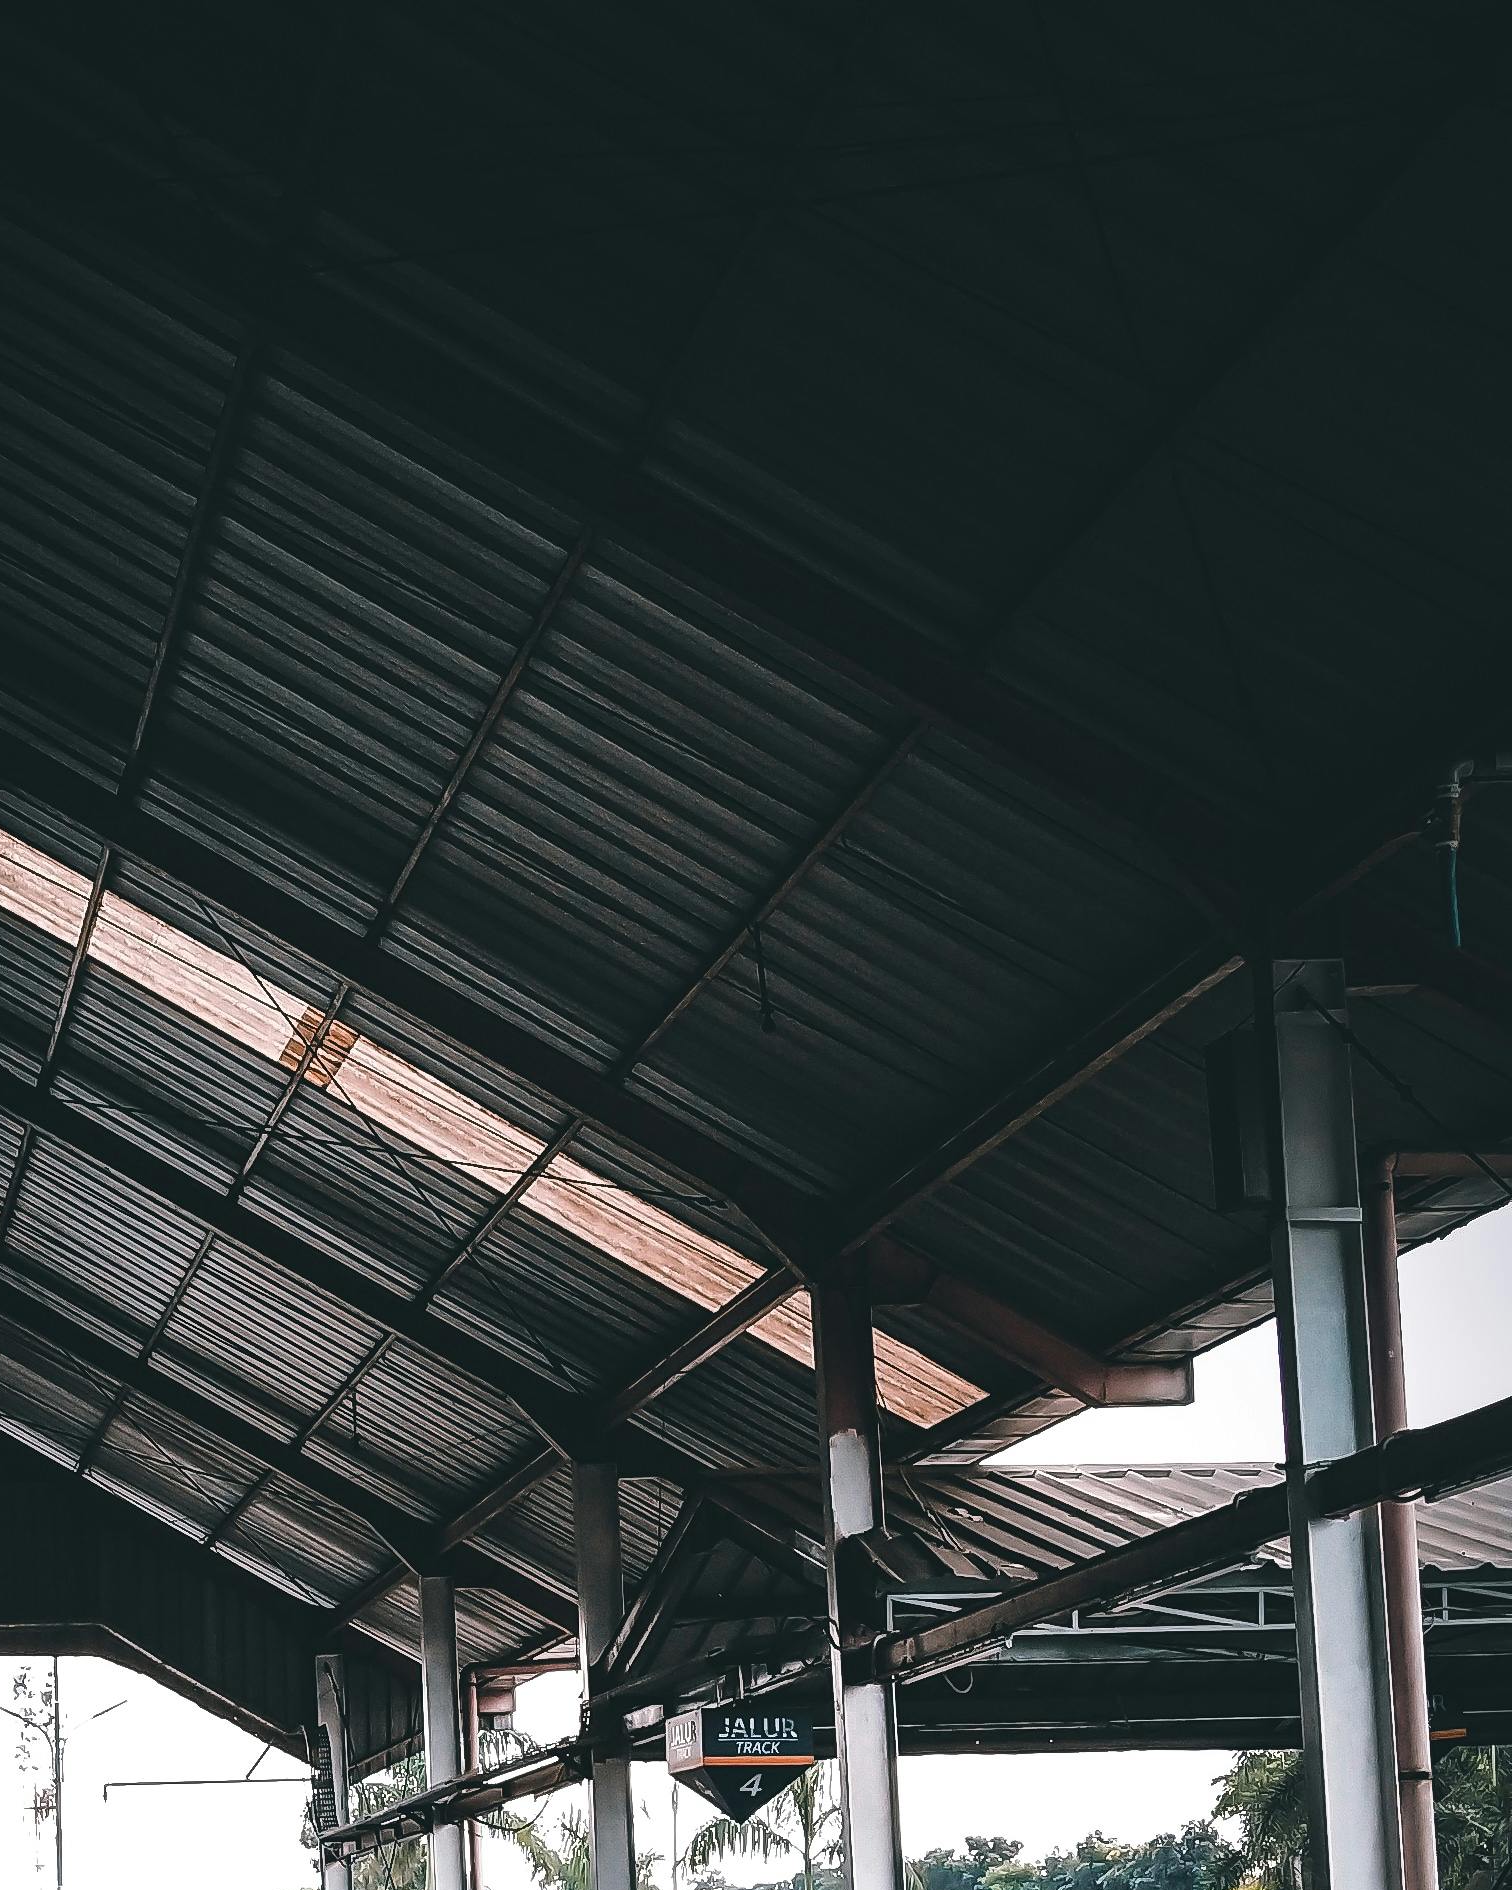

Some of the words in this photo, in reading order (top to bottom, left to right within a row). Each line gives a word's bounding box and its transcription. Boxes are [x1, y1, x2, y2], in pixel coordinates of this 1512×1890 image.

[670, 1720, 697, 1747] JALUR
[718, 1717, 798, 1738] JALUR
[736, 1741, 780, 1754] TRACK
[739, 1773, 763, 1797] 4
